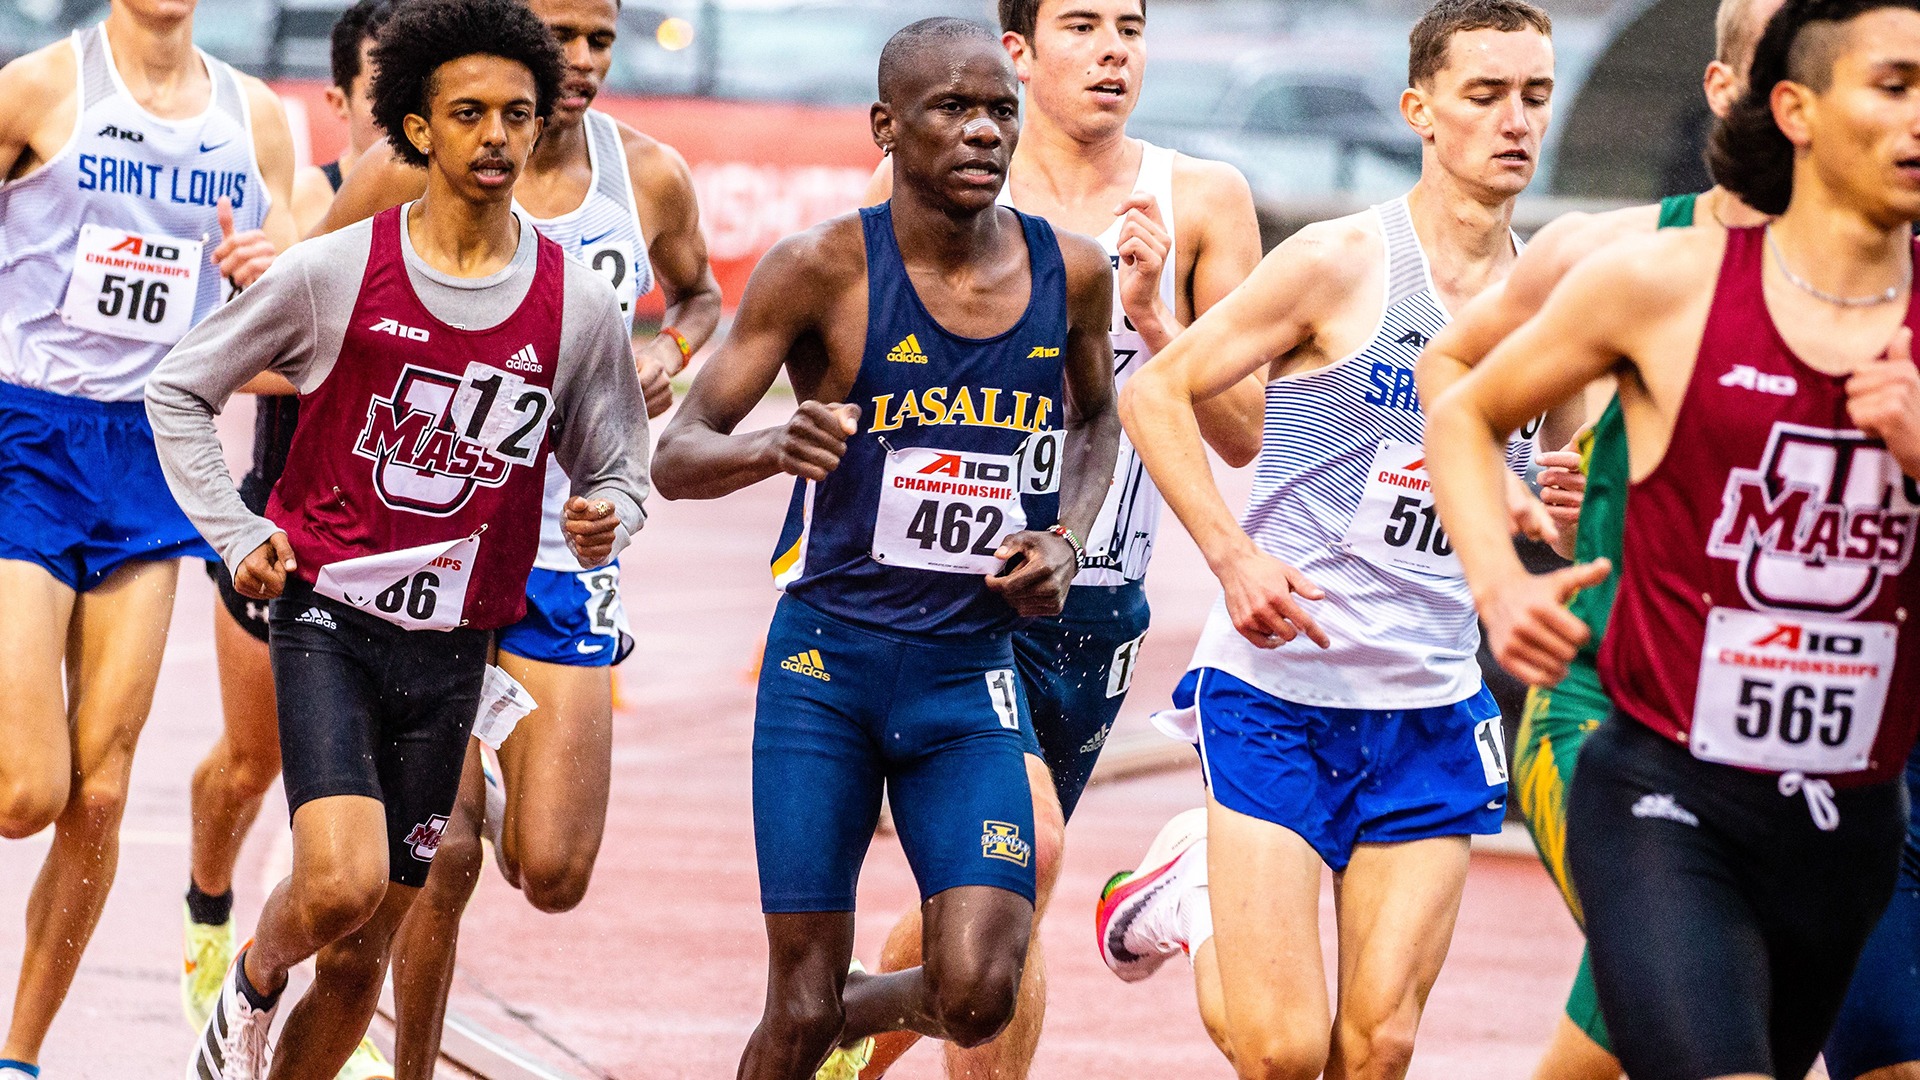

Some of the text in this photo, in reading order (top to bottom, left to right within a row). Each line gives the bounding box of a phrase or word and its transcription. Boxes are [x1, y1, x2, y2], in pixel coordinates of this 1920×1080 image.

[78, 153, 247, 209] SAINT LOUIS
[108, 235, 180, 261] A10
[85, 253, 190, 278] CHAMPIONSHIPS
[97, 274, 170, 324] 516
[369, 316, 430, 343] A10
[505, 356, 544, 374] adidas
[886, 349, 928, 365] adidas
[1027, 346, 1060, 360] A10
[1718, 363, 1798, 396] A10
[469, 373, 549, 460] 12
[916, 452, 1010, 483] A10
[906, 498, 1005, 556] 462
[1752, 624, 1863, 655] A10
[780, 660, 831, 682] adidas
[1719, 650, 1879, 679] CHAMPIONSHIPS
[1735, 677, 1856, 748] 565
